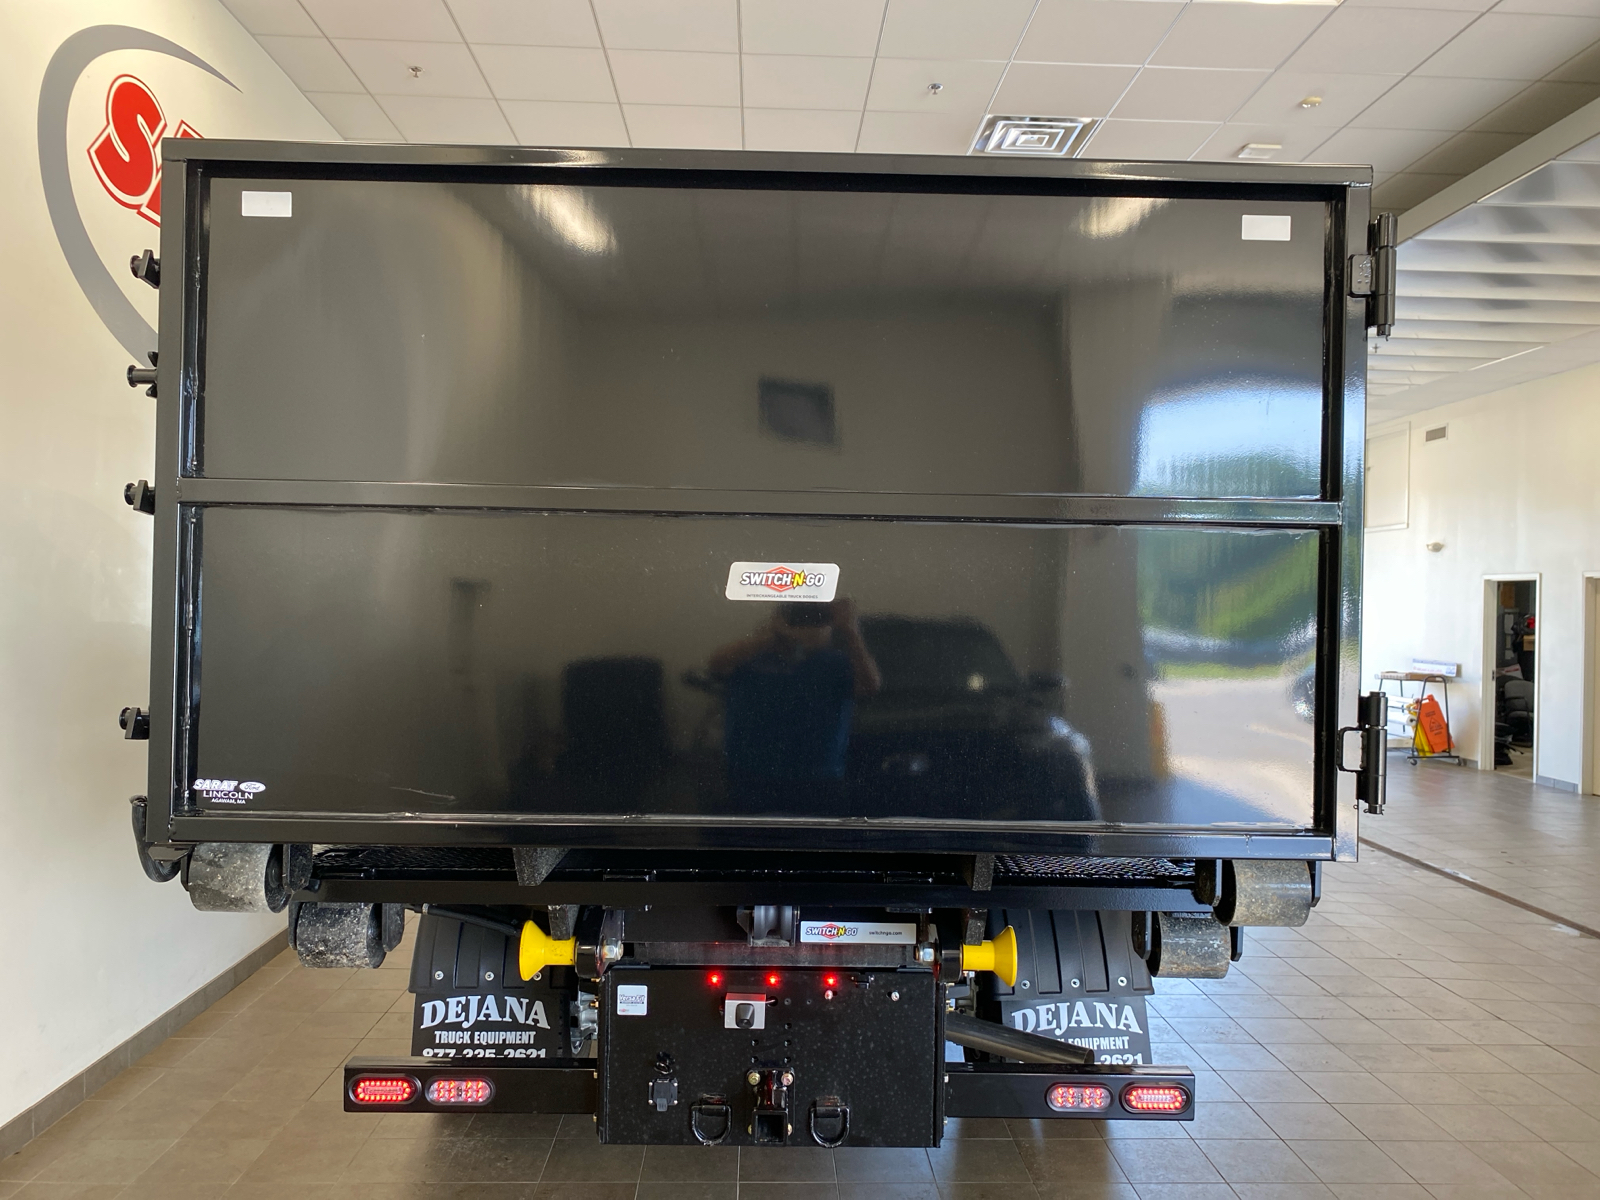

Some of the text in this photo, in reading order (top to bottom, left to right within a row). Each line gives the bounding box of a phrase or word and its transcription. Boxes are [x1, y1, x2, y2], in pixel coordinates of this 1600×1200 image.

[193, 779, 239, 791] SARAT
[203, 790, 253, 799] LINCOLN
[420, 994, 551, 1030] DEJANA
[1011, 1001, 1143, 1036] DEJANA
[434, 1031, 536, 1045] TRUCK EQUIPMENT
